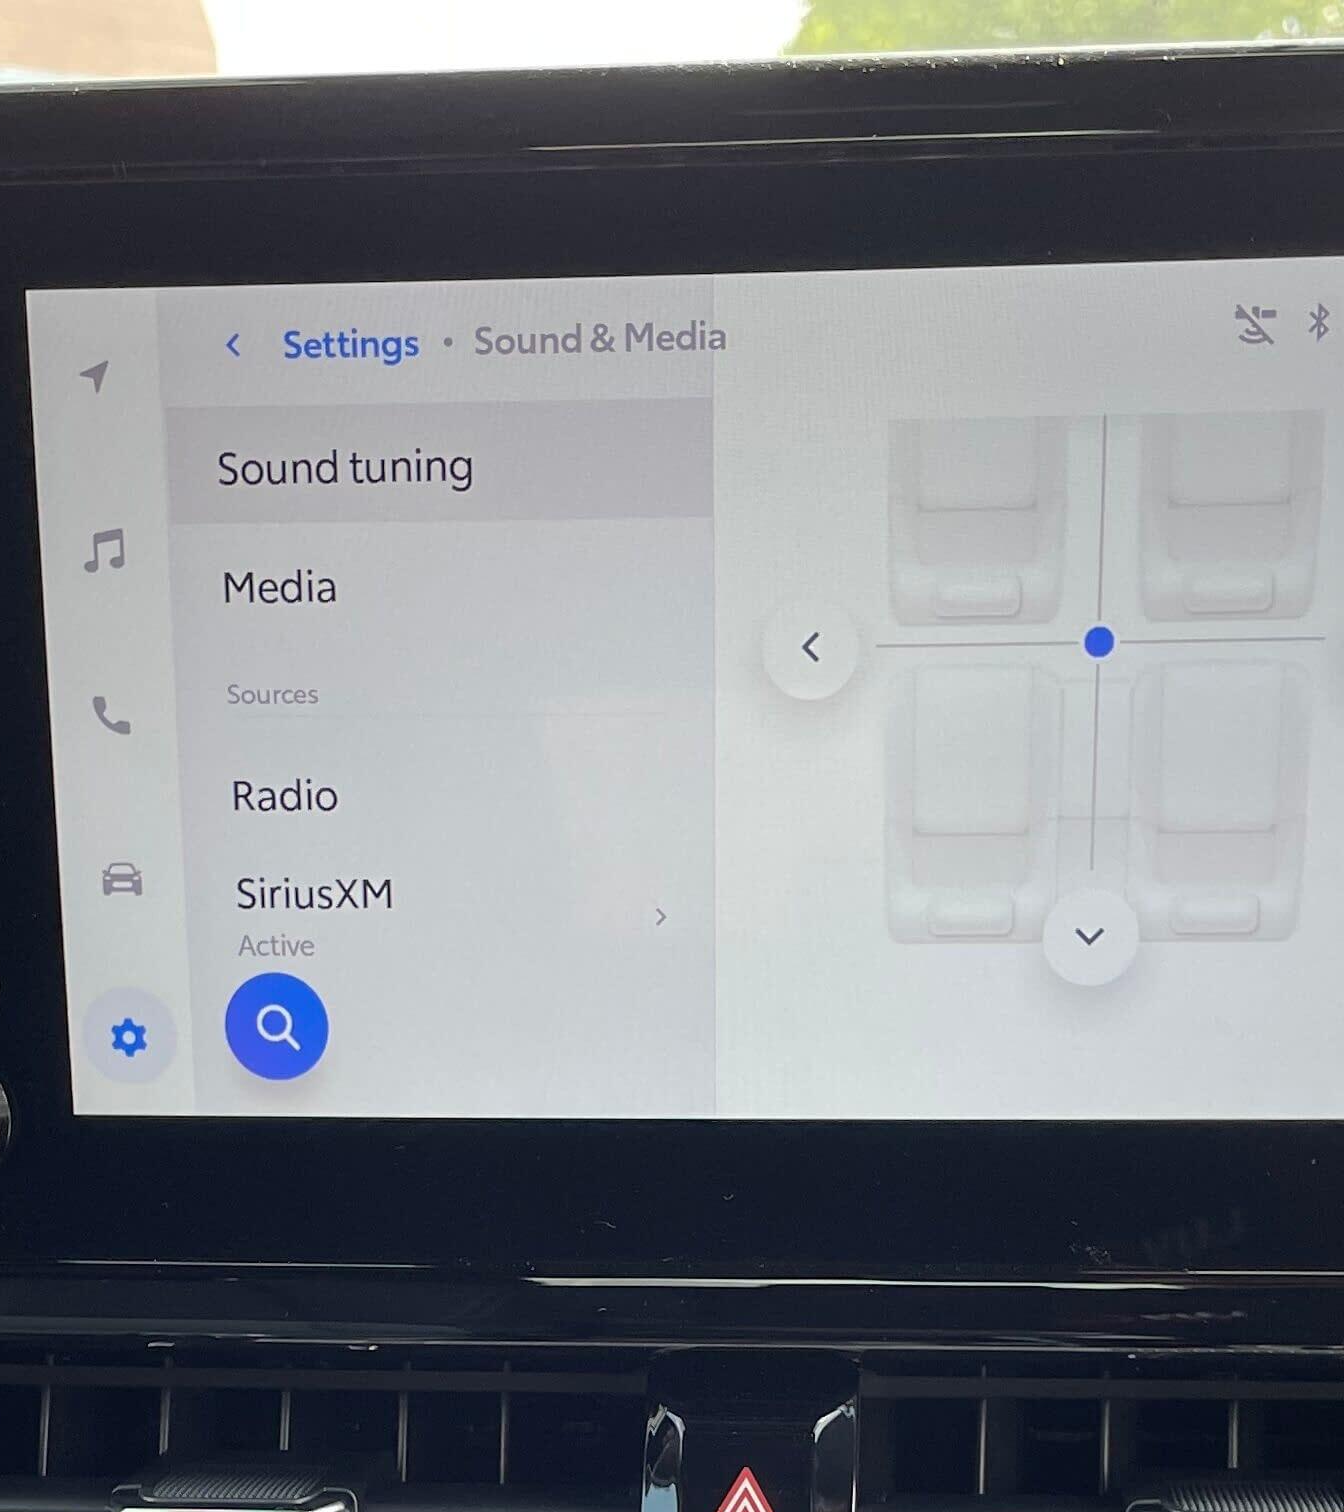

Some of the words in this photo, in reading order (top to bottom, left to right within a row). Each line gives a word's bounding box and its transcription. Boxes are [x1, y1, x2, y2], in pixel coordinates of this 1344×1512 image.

[282, 328, 420, 365] Settings
[473, 323, 582, 356] Sound
[590, 323, 616, 353] &
[623, 320, 727, 353] Media
[217, 449, 339, 487] Sound
[349, 448, 474, 491] tuning
[223, 569, 338, 604] Media
[226, 683, 319, 706] Sources
[232, 779, 338, 812] Radio
[236, 877, 394, 911] SiriusXM
[238, 933, 315, 958] Active
